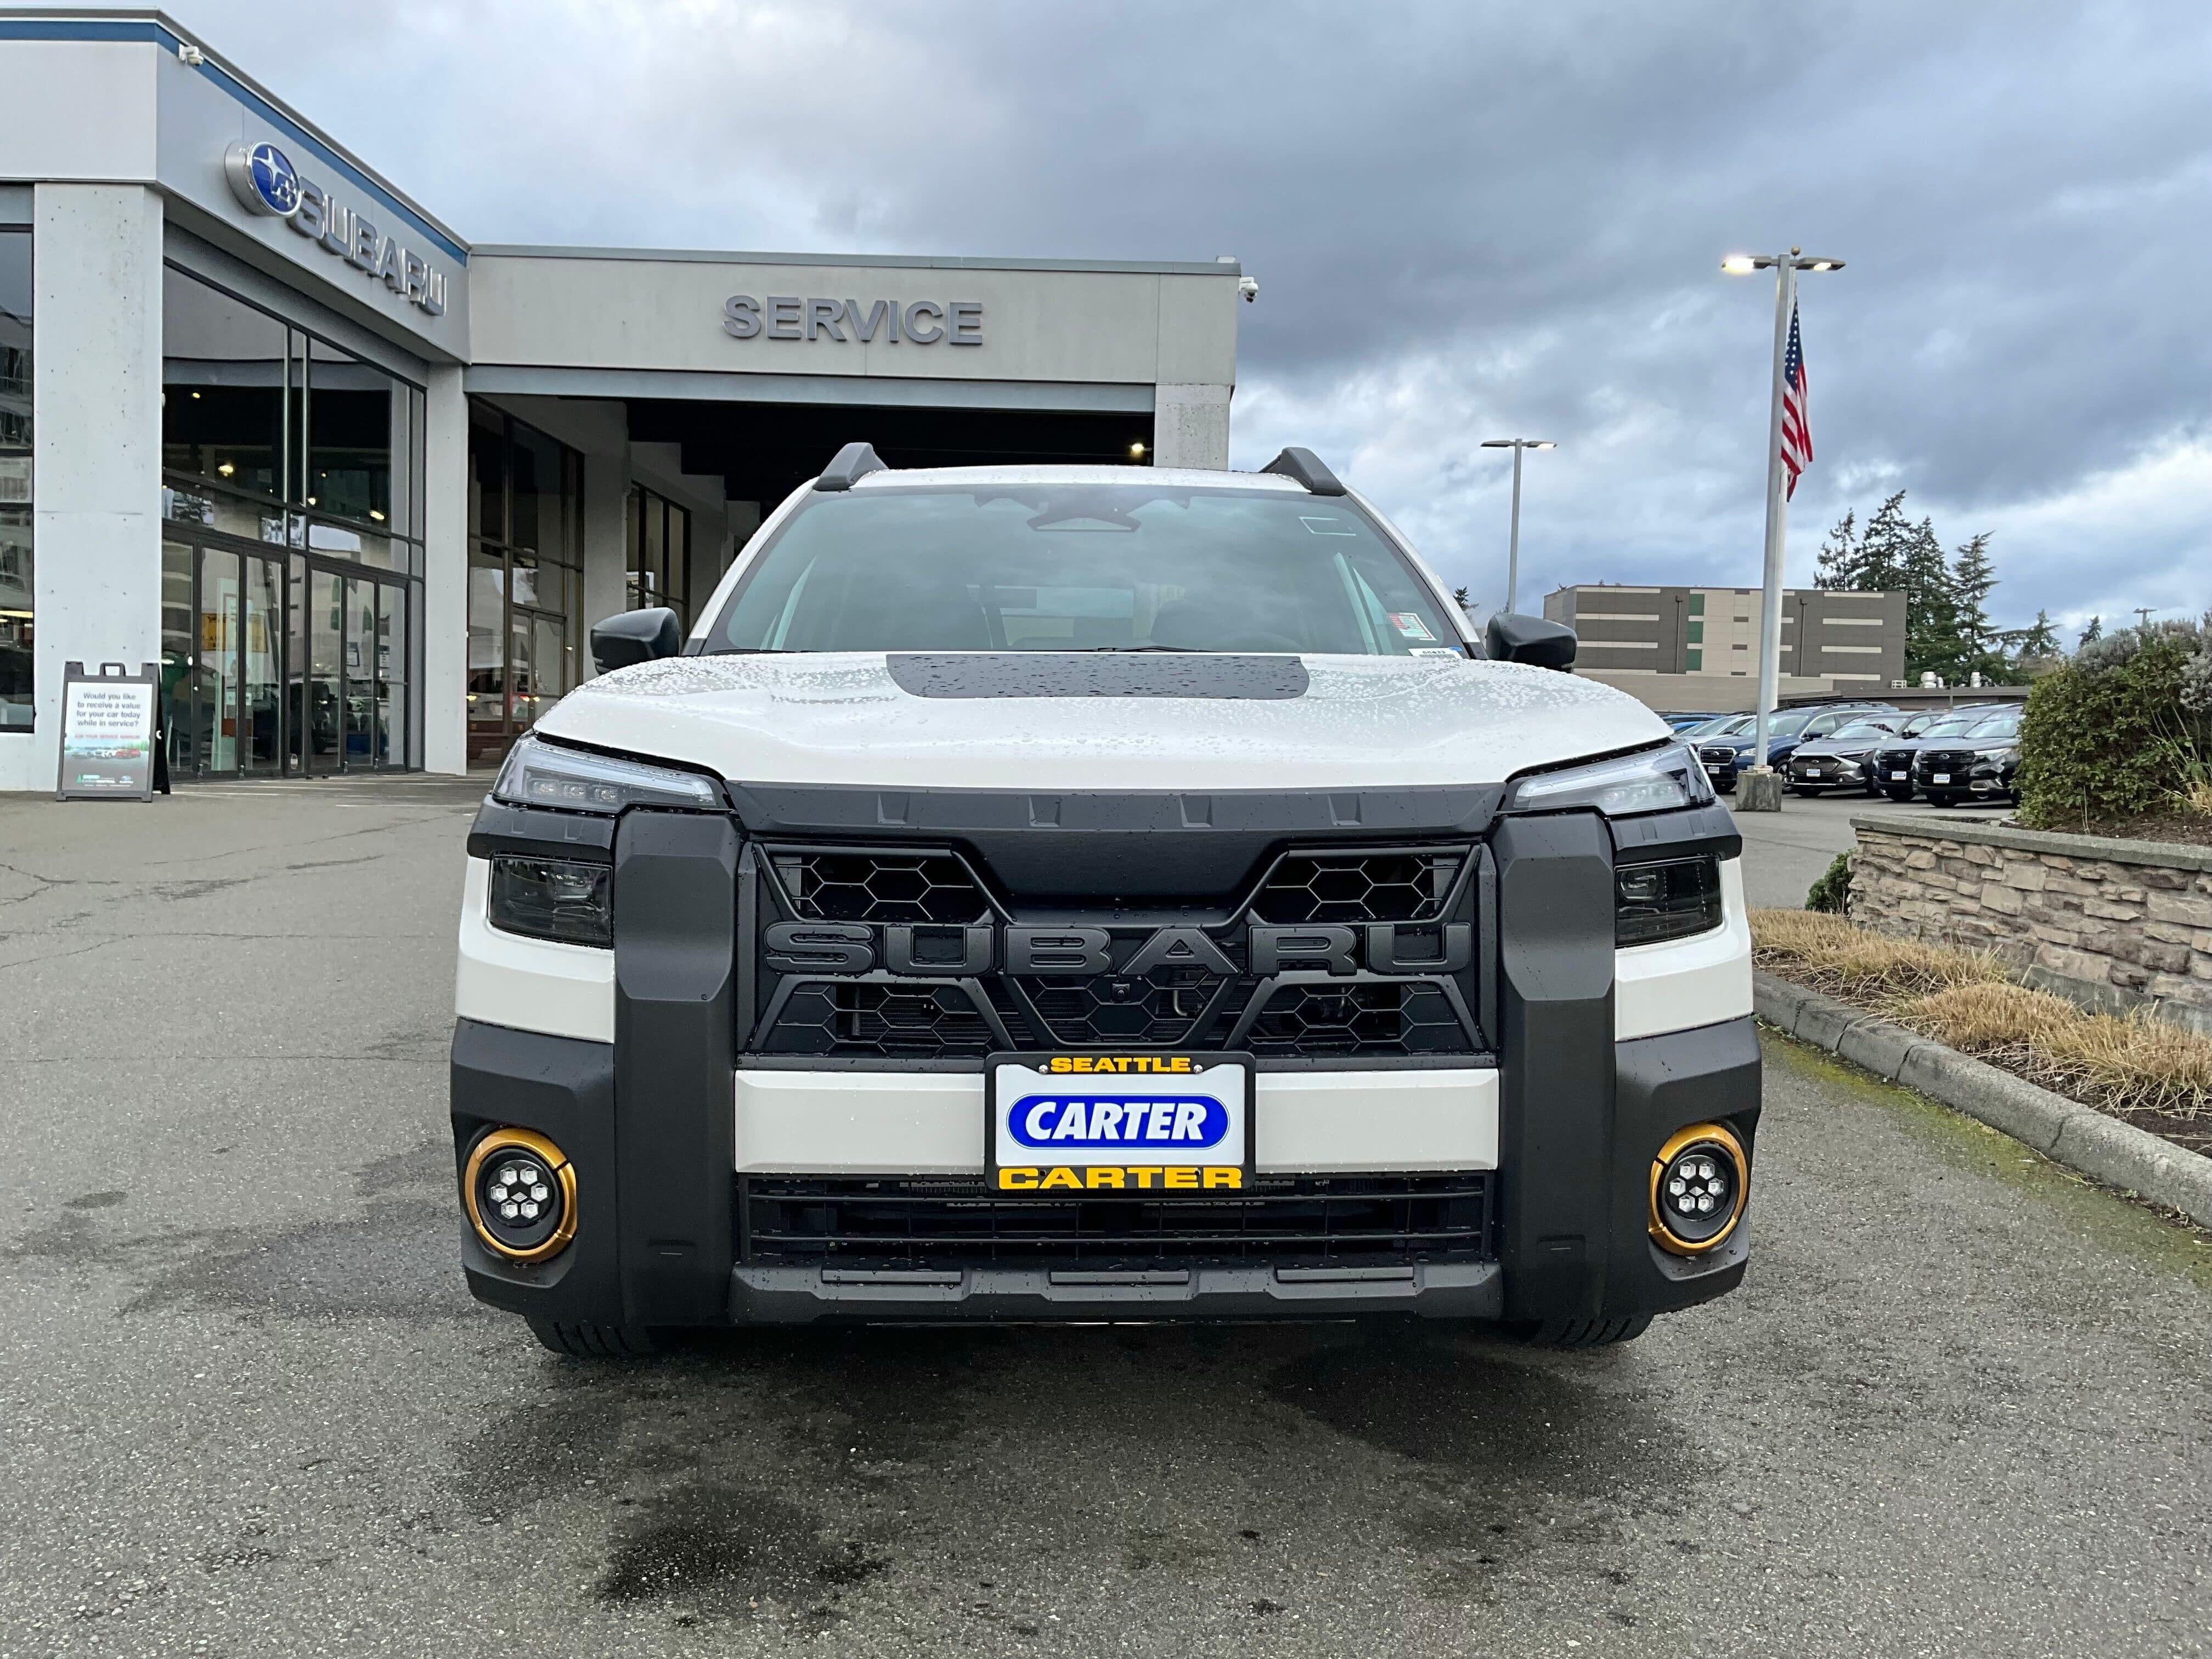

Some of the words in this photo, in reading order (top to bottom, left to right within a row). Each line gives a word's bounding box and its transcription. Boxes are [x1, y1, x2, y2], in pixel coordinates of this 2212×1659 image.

[286, 176, 447, 316] SUBARU
[723, 295, 983, 346] SERVICE
[765, 922, 1472, 979] SUBARU
[1051, 1057, 1190, 1072] SEATTLE
[1025, 1102, 1206, 1140] CARTER
[998, 1167, 1242, 1189] CARTER
